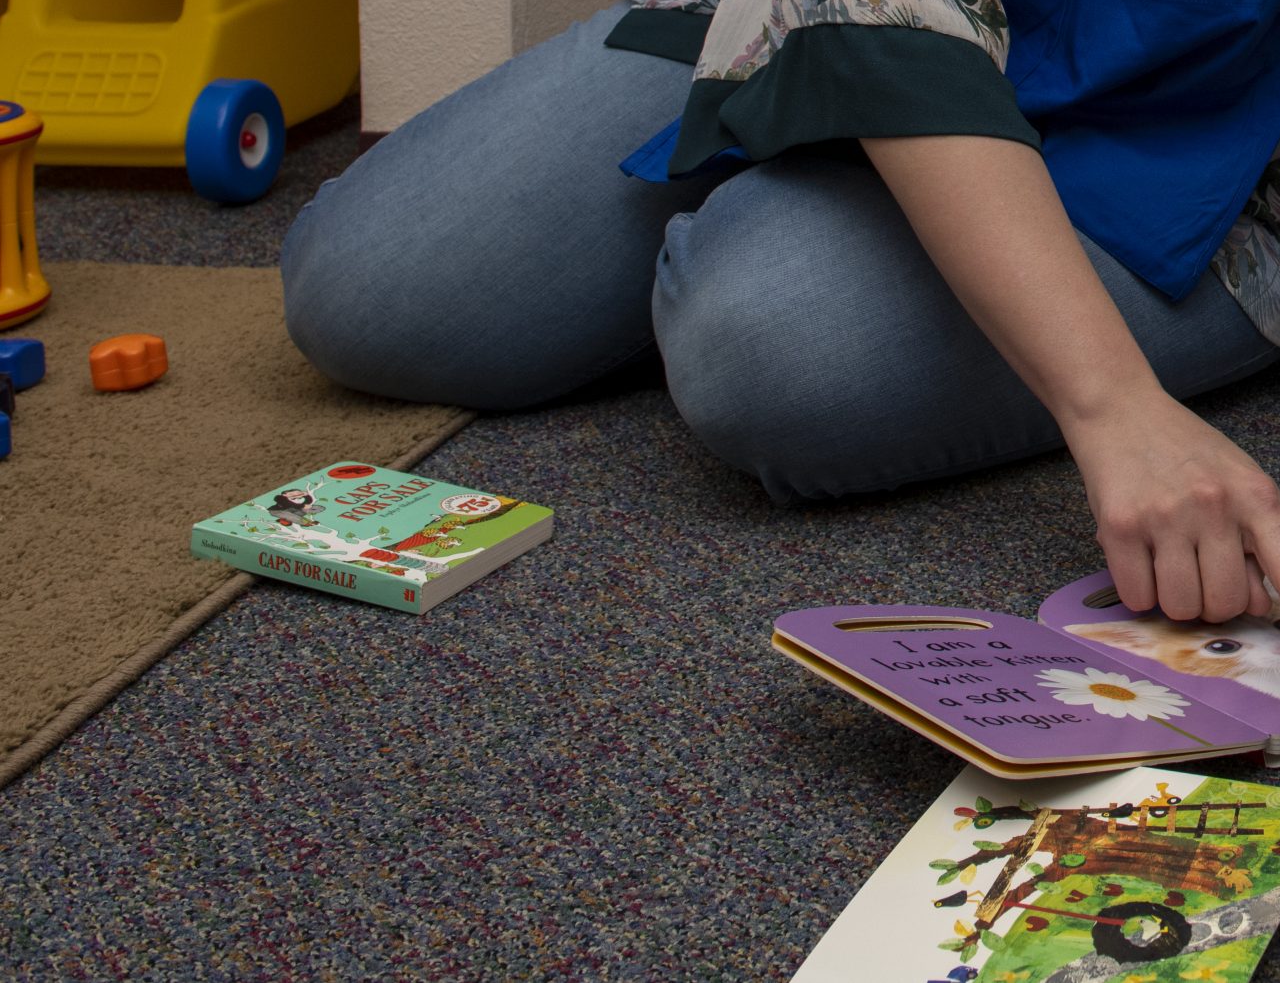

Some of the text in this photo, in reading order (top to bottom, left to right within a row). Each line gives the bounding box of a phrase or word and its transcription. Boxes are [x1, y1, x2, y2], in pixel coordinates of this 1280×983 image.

[334, 481, 391, 506] CAPS
[337, 499, 392, 522] FOR
[383, 478, 436, 502] SALE
[258, 551, 357, 590] CAPS FOR SALE
[892, 640, 1013, 653] I am a
[870, 655, 1086, 672] lovable kitten
[919, 672, 993, 686] with
[938, 687, 1037, 707] a soft
[963, 712, 1091, 730] tongue.
